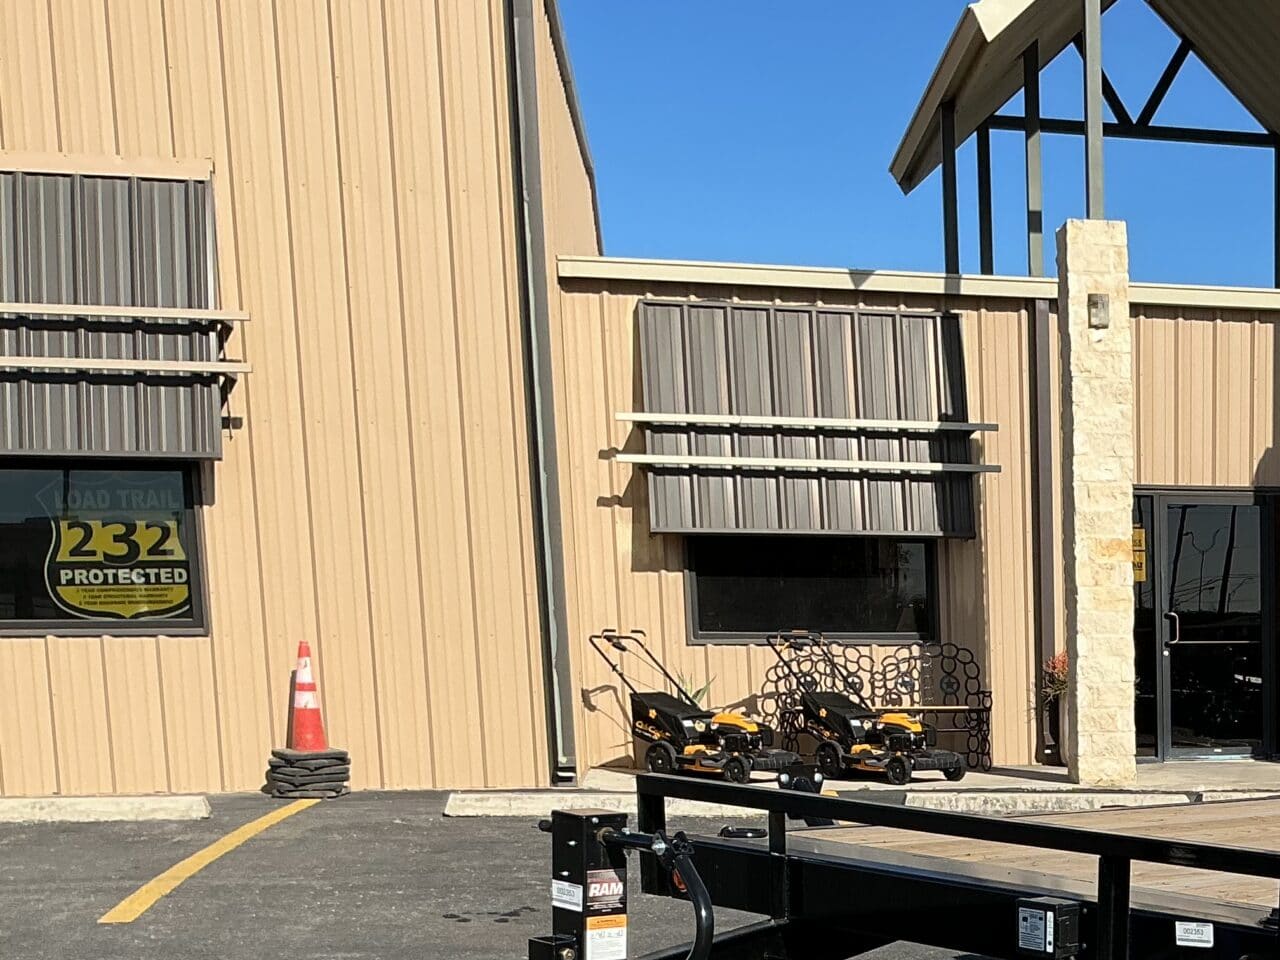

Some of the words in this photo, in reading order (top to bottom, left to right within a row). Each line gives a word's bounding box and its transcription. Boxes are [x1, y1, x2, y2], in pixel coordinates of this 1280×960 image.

[54, 488, 110, 510] LOAD
[117, 488, 181, 510] TRAIL
[67, 517, 175, 564] 232
[60, 568, 187, 584] PROTECTED
[588, 882, 623, 898] RAM
